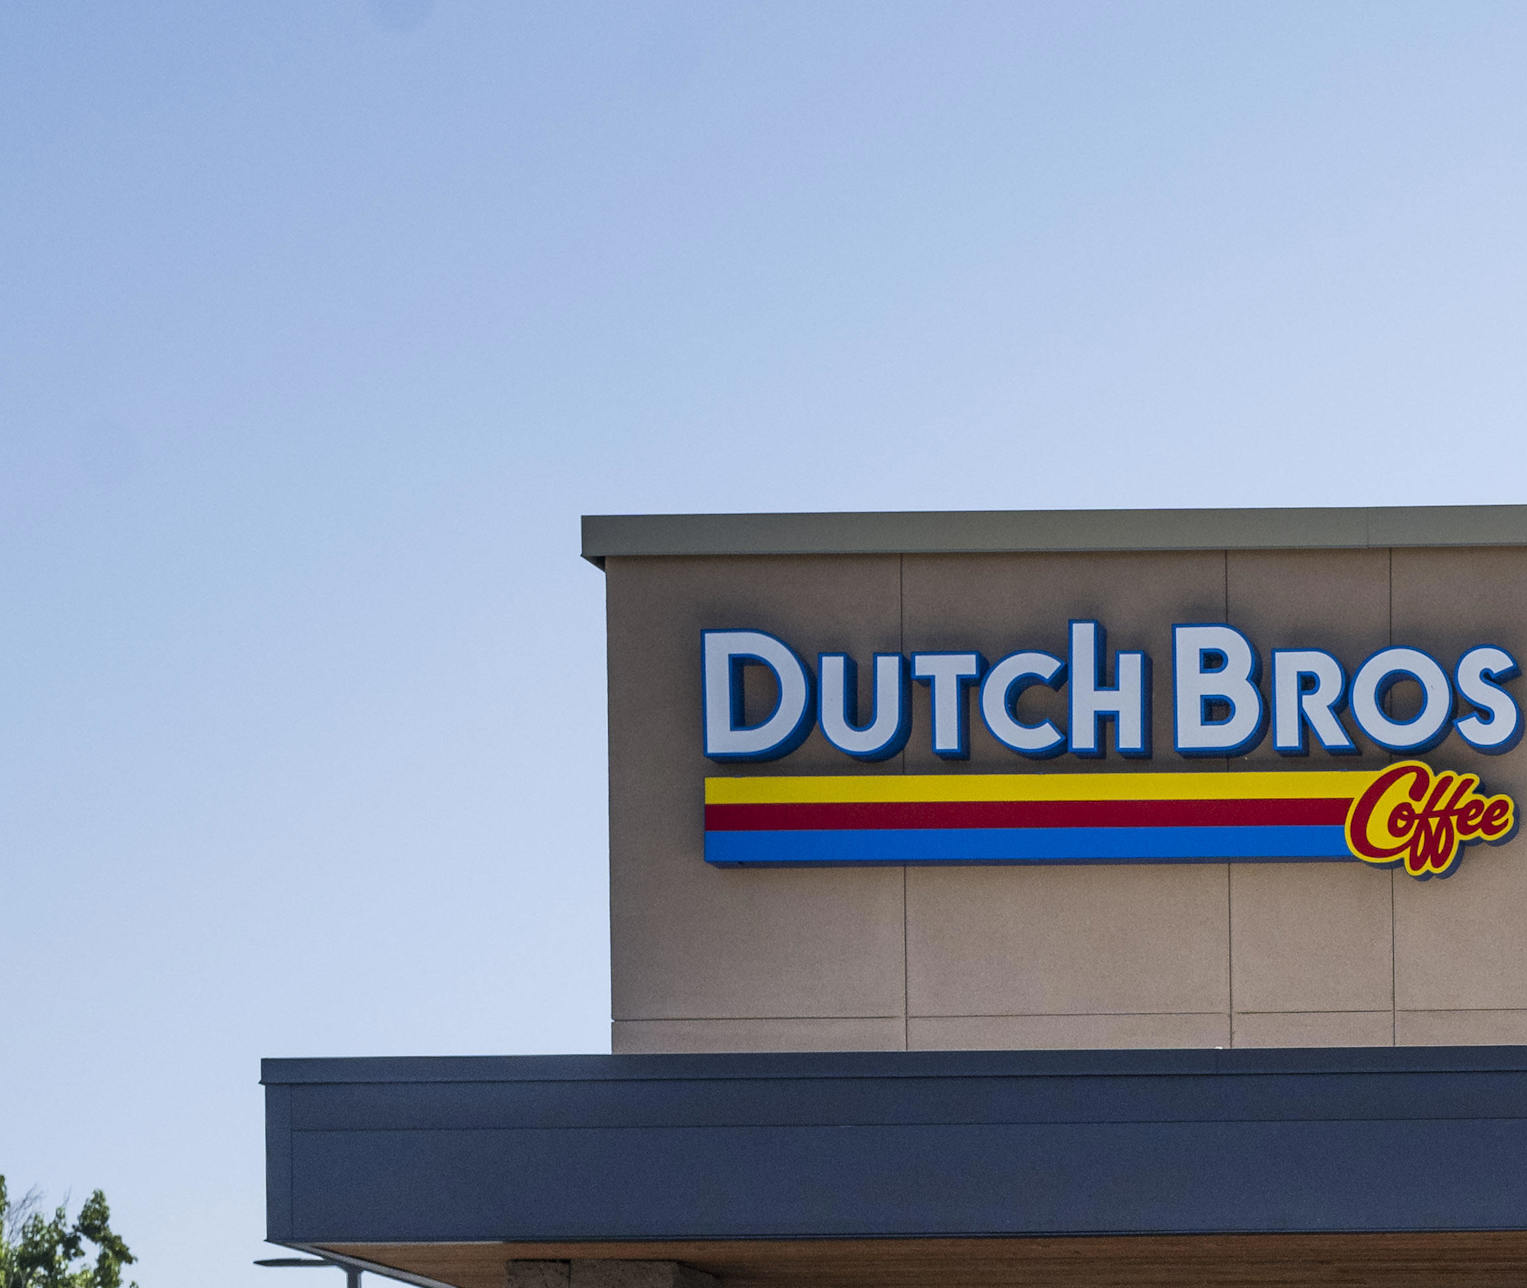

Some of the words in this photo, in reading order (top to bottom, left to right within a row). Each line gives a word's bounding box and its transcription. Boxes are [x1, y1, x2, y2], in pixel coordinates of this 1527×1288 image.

[702, 619, 1150, 760] DUTCH
[1172, 623, 1522, 755] BROS
[1349, 763, 1511, 872] Coffee
